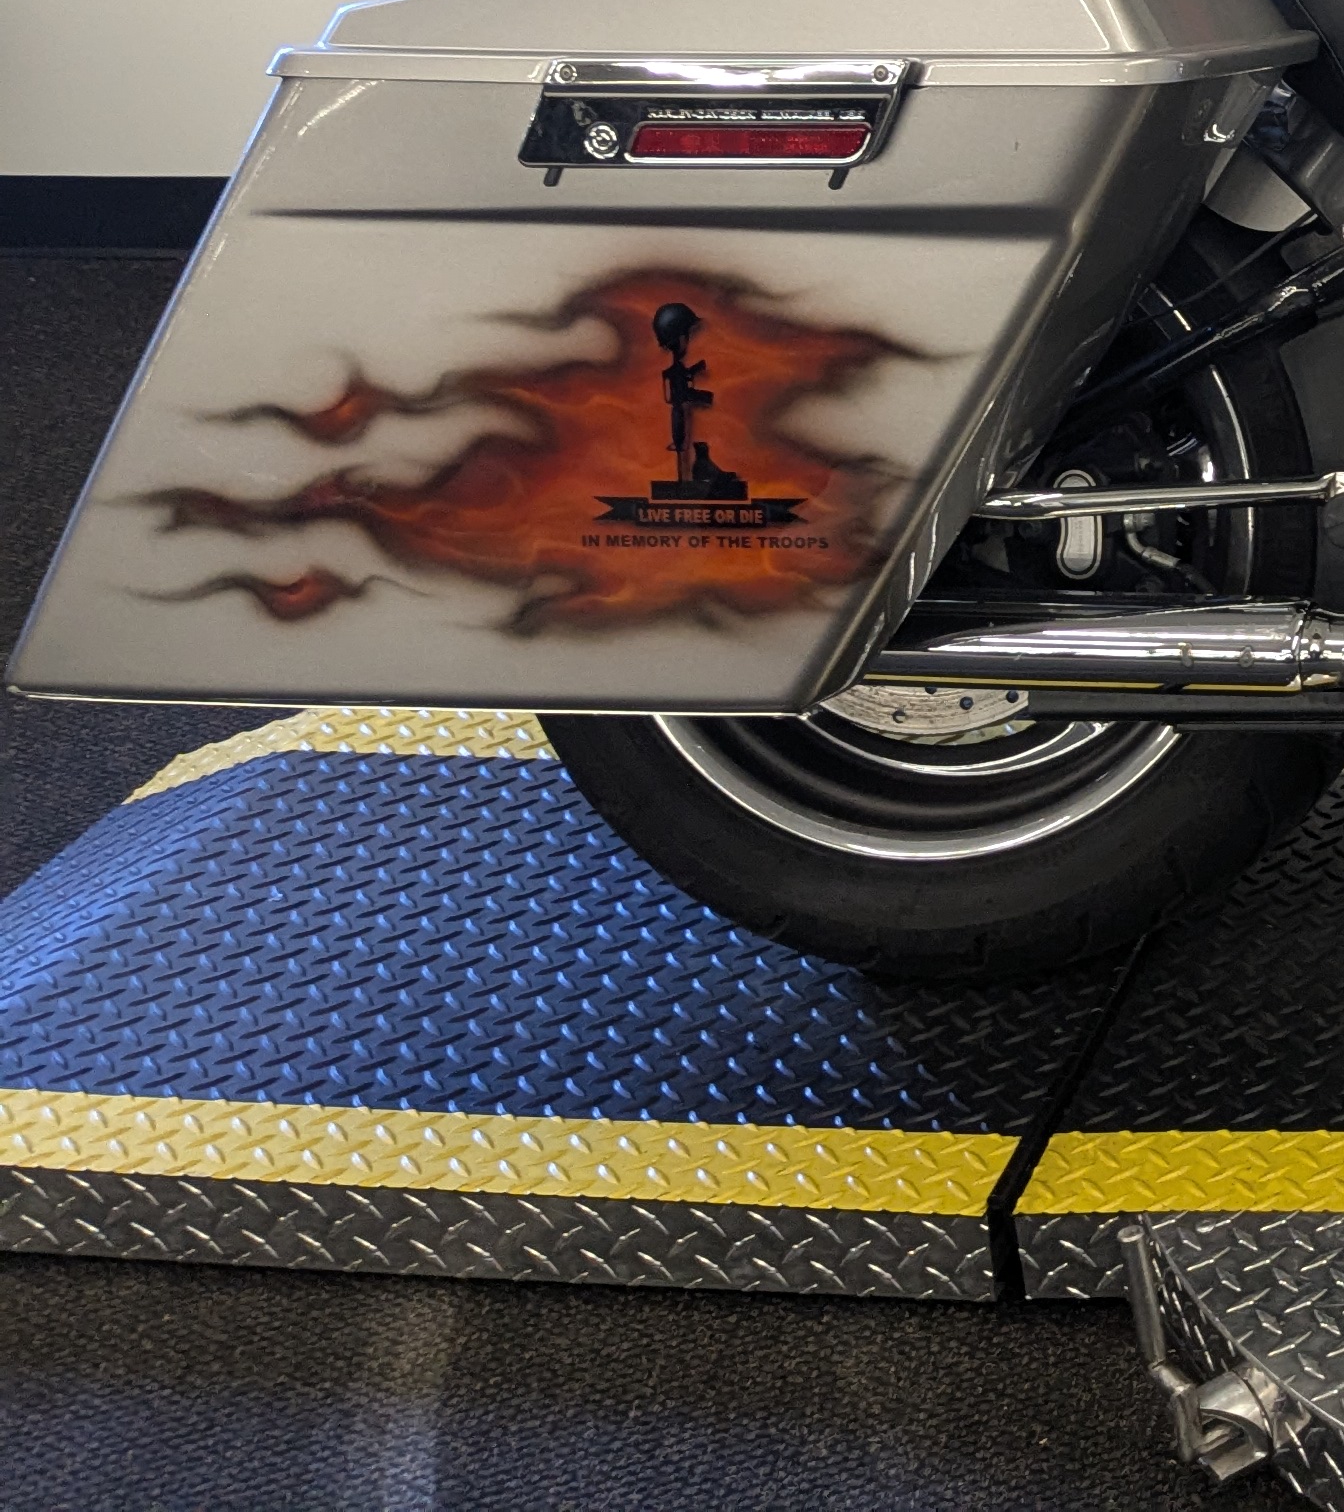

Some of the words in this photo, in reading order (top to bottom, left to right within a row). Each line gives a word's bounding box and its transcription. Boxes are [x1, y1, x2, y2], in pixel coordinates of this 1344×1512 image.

[638, 508, 671, 522] LIVE
[674, 508, 712, 524] FREE
[716, 509, 736, 523] OR
[739, 509, 763, 524] DIE
[581, 535, 600, 547] IN
[605, 535, 681, 548] MEMORY
[687, 536, 710, 549] OF
[716, 536, 753, 549] THE
[758, 536, 829, 550] TROOPS
